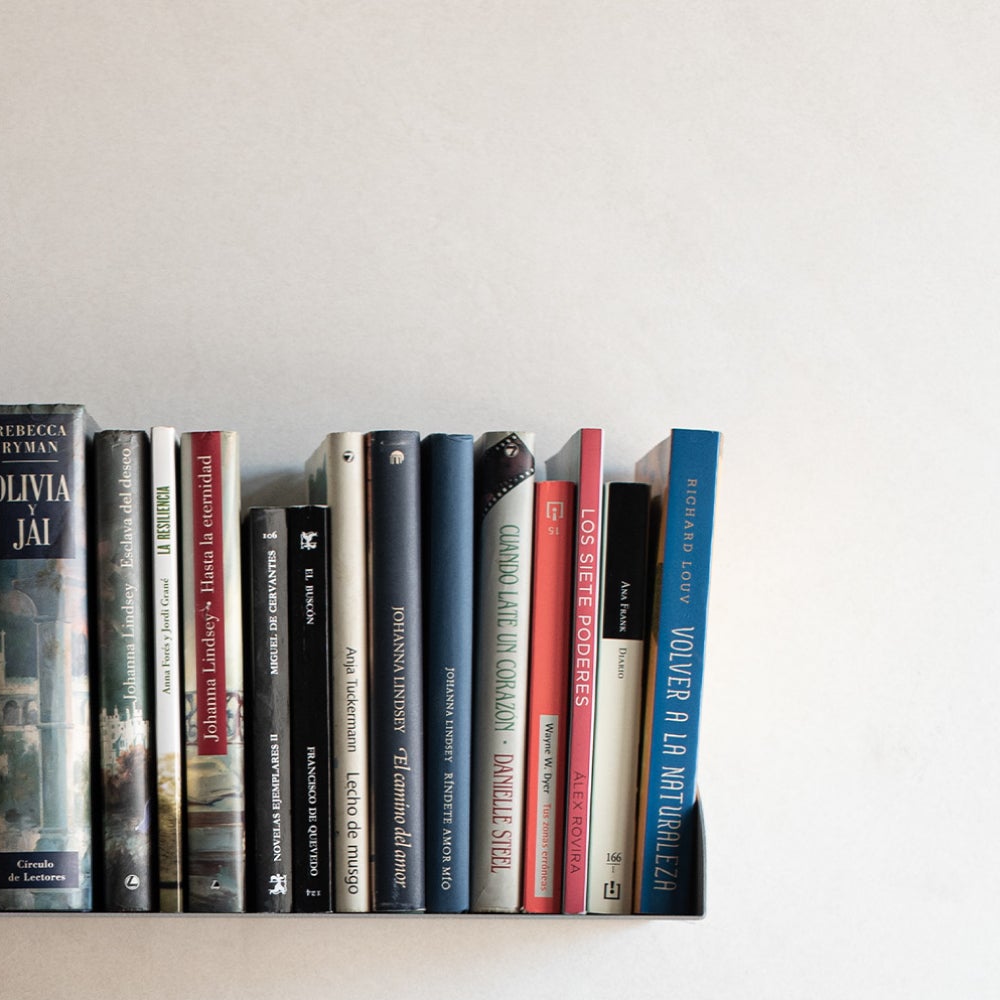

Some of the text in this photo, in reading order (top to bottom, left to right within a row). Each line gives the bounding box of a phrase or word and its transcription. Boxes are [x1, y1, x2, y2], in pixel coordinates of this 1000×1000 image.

[3, 442, 59, 453] RYMAN
[13, 518, 50, 550] JAI
[156, 486, 171, 540] RESILIENCIA
[679, 478, 697, 604] RICHARD LOUV
[118, 447, 139, 702] Johanna Lindsey Esclava deseo
[197, 455, 220, 742] Johanna Lindsey Hasta eternidad
[267, 550, 279, 675] MIGUEL CERVANTES
[305, 585, 315, 624] BUSCÓN
[494, 524, 519, 732] CUANDO LATE CORAZÓN
[574, 508, 595, 706] LOS SIETE PODERES
[159, 578, 171, 695] Anna Forés Jordi Grané
[270, 743, 282, 862] NOVELAS EJEMPLARES
[345, 680, 360, 895] Tuckermann Lecho musgo
[391, 606, 409, 887] JOHANNA LINDSEY camino amor
[542, 723, 553, 793] Wayne Dyer
[653, 627, 694, 891] VOLVER NATURALEZA
[16, 860, 54, 869] Círculo
[306, 746, 317, 876] FRANCISCO QUEVEDO
[442, 772, 454, 861] RÍNDETE AMOR
[491, 754, 513, 874] DANIELLE STEEL
[569, 772, 585, 874] ÁLEX ROVIRA
[606, 852, 621, 863] 166
[24, 873, 66, 882] Lectores
[541, 851, 549, 891] erróneas
